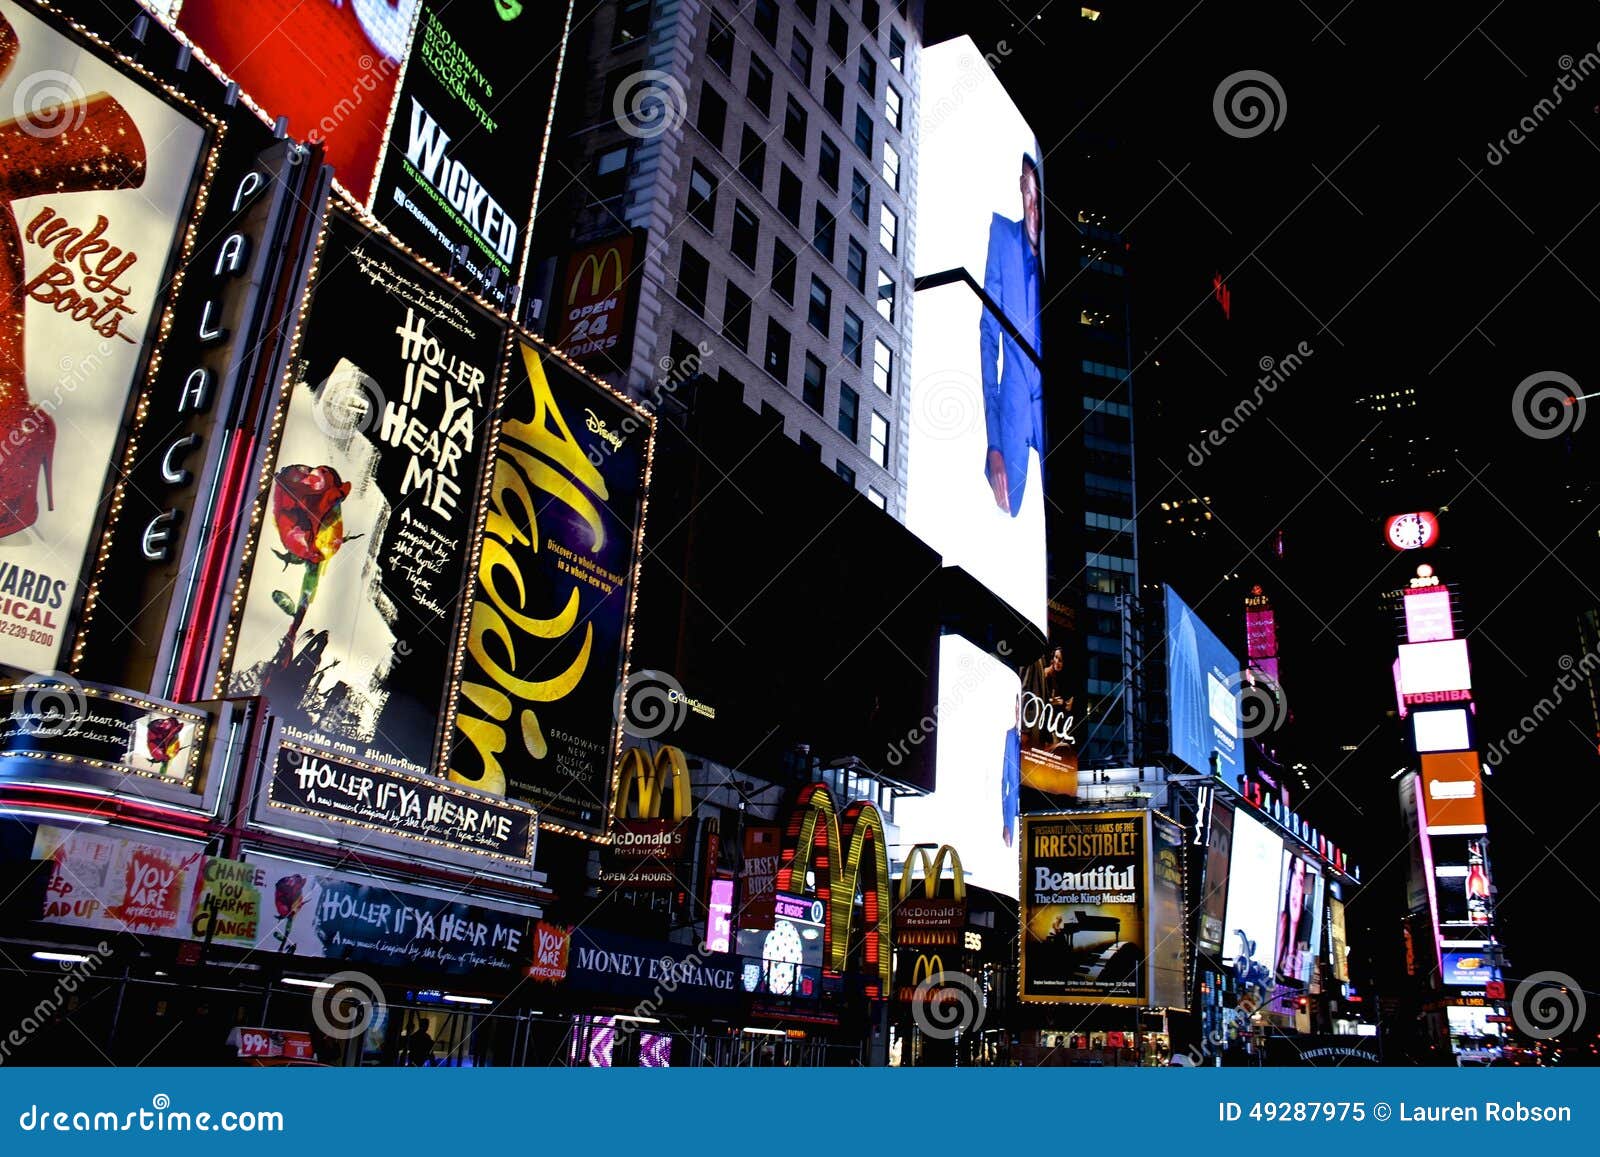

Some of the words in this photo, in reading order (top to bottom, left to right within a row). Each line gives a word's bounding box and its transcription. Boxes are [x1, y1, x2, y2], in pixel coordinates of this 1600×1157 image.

[403, 94, 518, 265] WICKED
[25, 262, 137, 345] Boots
[569, 298, 617, 320] OPEN
[570, 314, 609, 342] 24
[395, 307, 485, 408] HOLLER
[565, 335, 618, 357] OURS
[402, 363, 440, 411] IF
[439, 380, 474, 453] YA
[380, 401, 462, 477] HEAR
[585, 408, 622, 453] Disney
[400, 455, 461, 521] ME
[400, 507, 411, 525] A
[392, 540, 413, 557] the
[547, 538, 573, 561] Discover
[400, 565, 432, 590] Tupac
[0, 600, 57, 629] ICAL
[1404, 688, 1472, 705] TOSHIBA
[1022, 691, 1076, 745] Once
[550, 728, 605, 755] BROADWAY'S
[567, 746, 587, 758] NEW
[556, 753, 594, 773] MUSICAL
[556, 765, 593, 783] COMEDY
[294, 756, 374, 809] HOLLER
[376, 783, 399, 810] IF
[399, 786, 422, 819] YA
[427, 794, 479, 832] HEAR
[480, 810, 512, 842] ME
[133, 859, 175, 896] YOU
[641, 873, 673, 882] HOURS
[743, 855, 780, 877] JERSEY
[1034, 864, 1136, 891] Beautiful
[218, 881, 243, 899] YOU
[748, 876, 775, 895] BOYS
[75, 900, 100, 919] UP
[132, 887, 169, 910] ARE
[204, 893, 235, 912] HEAR
[1035, 893, 1051, 904] The
[1051, 893, 1079, 904] Carole
[1080, 892, 1101, 906] King
[1101, 892, 1136, 904] Musical
[323, 889, 391, 935] HOLLER
[394, 906, 414, 933] IF
[414, 908, 437, 940] YA
[440, 913, 488, 947] HEAR
[492, 923, 522, 953] ME
[897, 906, 963, 918] McDonald's
[192, 913, 257, 939] CANGE
[538, 928, 563, 949] YOU
[537, 950, 561, 967] ARE
[577, 947, 646, 977] MONEY
[648, 957, 735, 990] EXCHANGE
